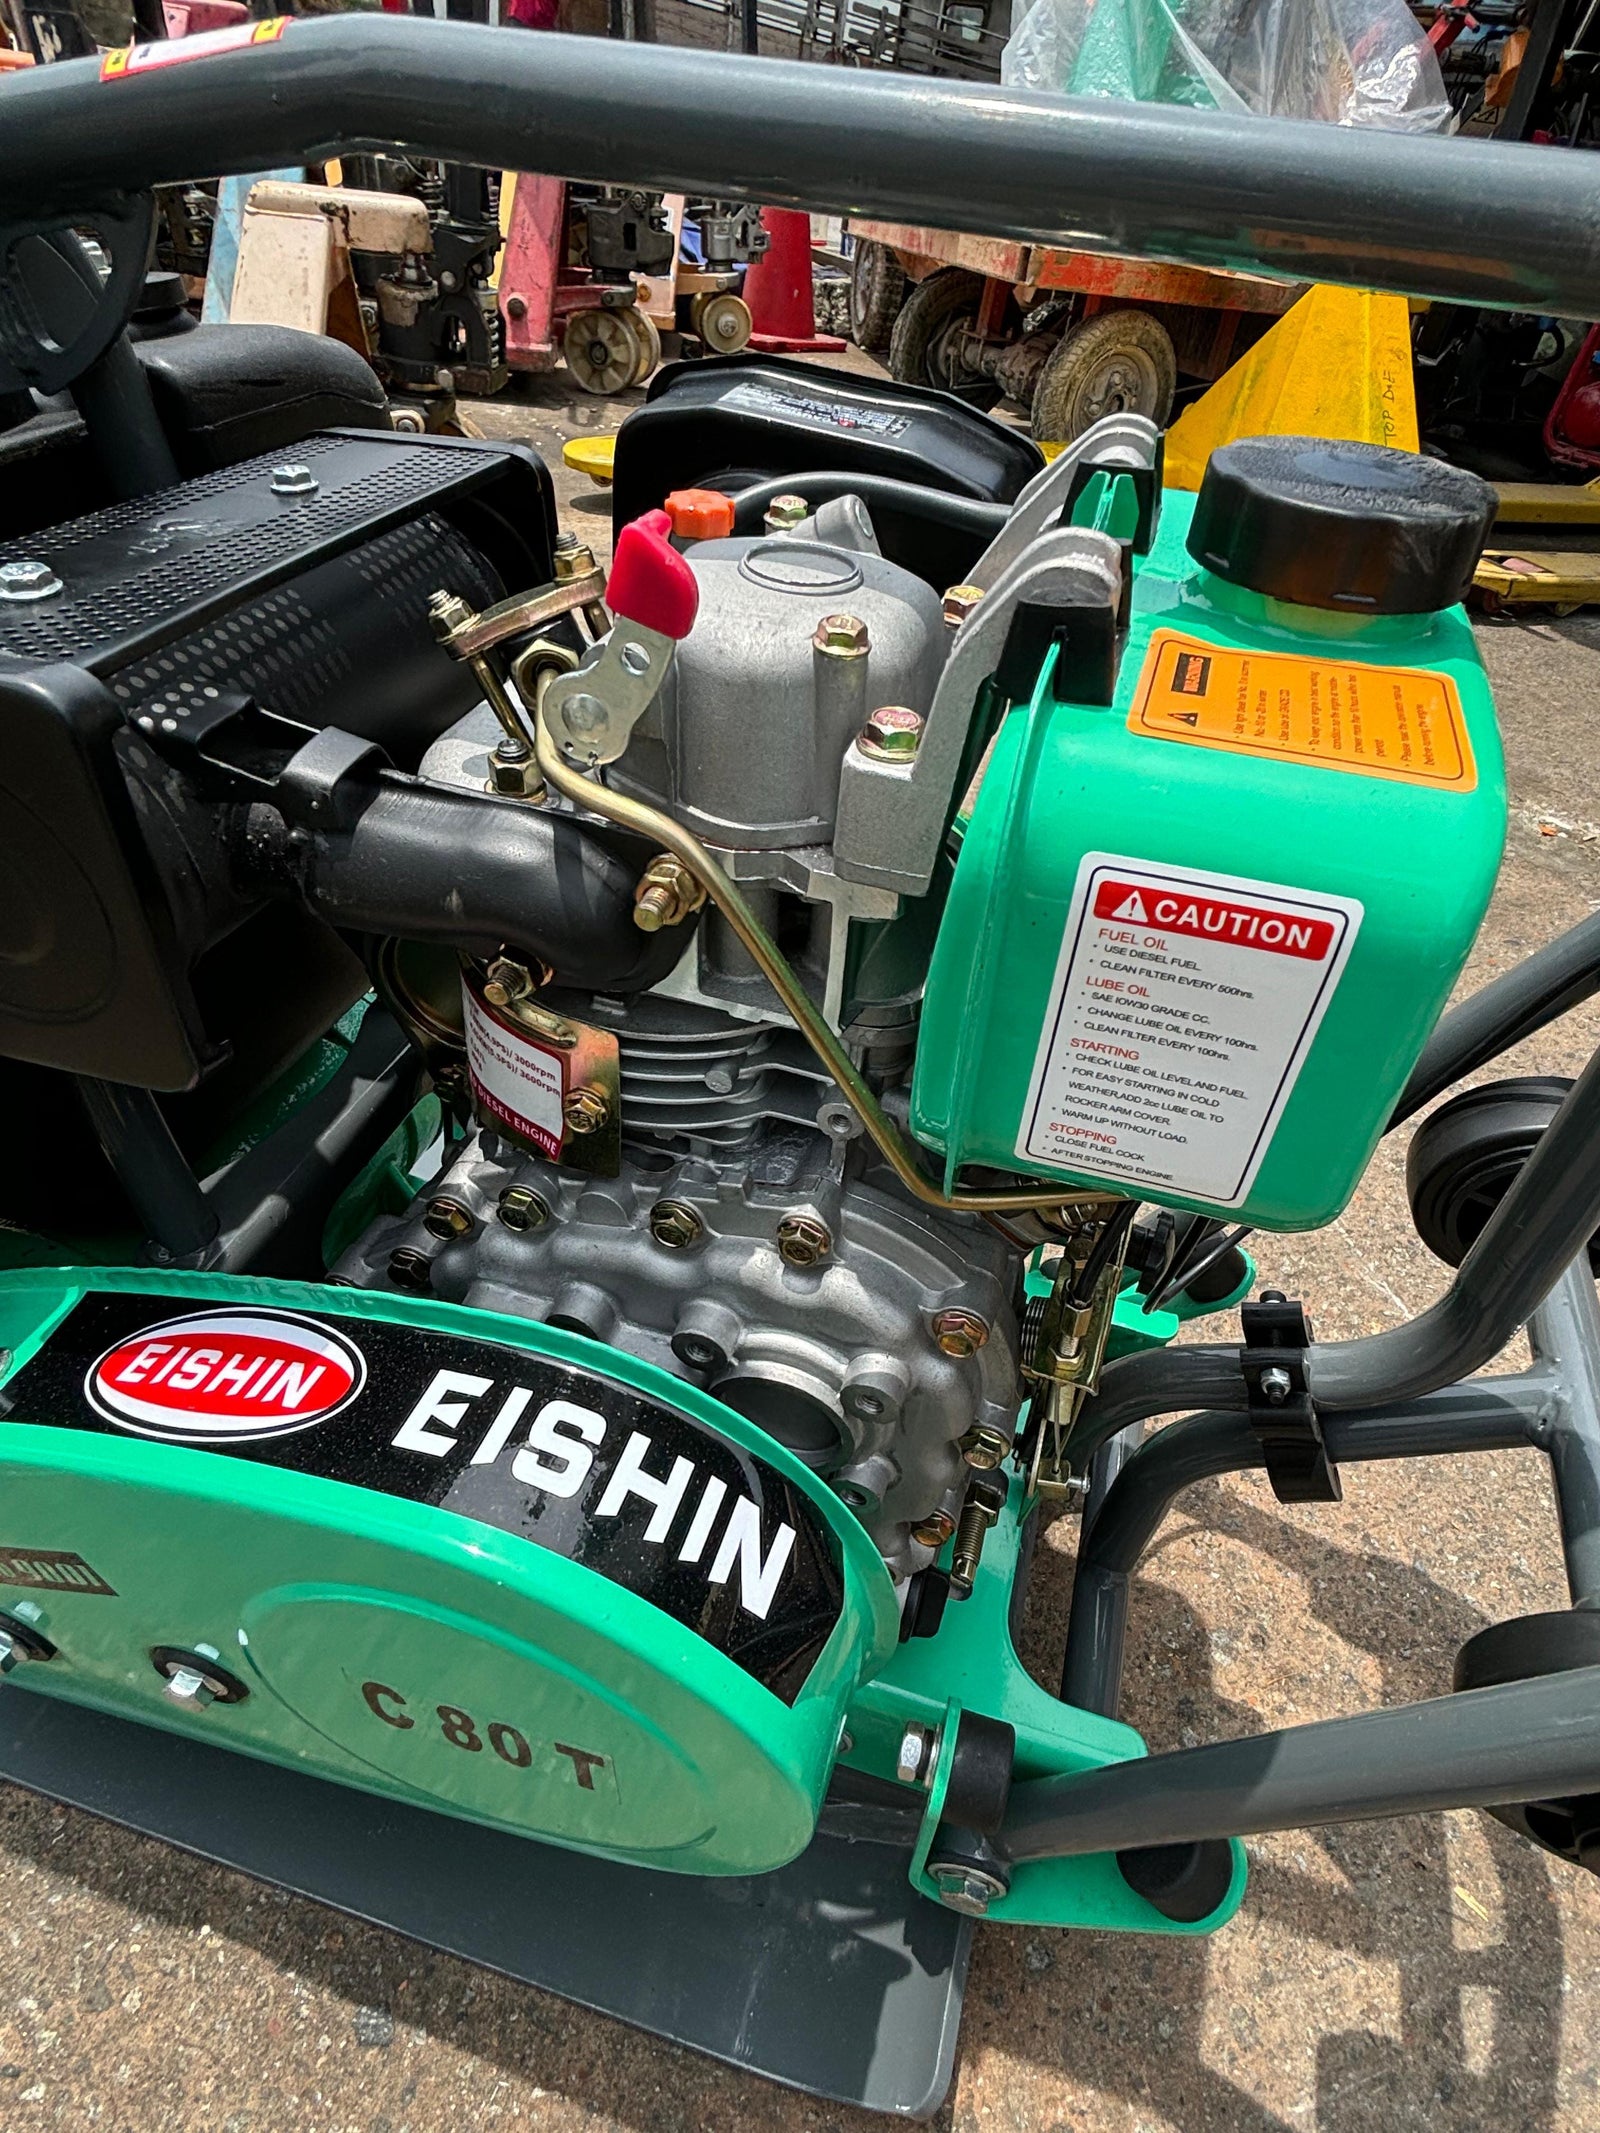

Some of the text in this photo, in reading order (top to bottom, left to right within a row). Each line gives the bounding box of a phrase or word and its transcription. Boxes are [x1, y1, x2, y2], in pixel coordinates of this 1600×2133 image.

[1154, 899, 1313, 950] CAUTION
[1099, 928, 1168, 951] FUEL OIL
[1105, 944, 1128, 955] USE
[1130, 949, 1168, 965] DIESEL
[1086, 976, 1150, 997] LUBE OIL
[1100, 960, 1137, 974] CLEAN
[1139, 969, 1176, 983] FILTER
[1178, 977, 1218, 990] EVERY
[1091, 992, 1113, 1002] SAE
[1151, 1005, 1190, 1019] GRADE
[1084, 1021, 1119, 1035] CLEAN
[1120, 1030, 1156, 1044] FILTER
[1158, 1038, 1195, 1052] EVERY
[1088, 1007, 1133, 1022] CHANGE
[1135, 1017, 1163, 1029] LUBE
[1165, 1024, 1182, 1034] OIL
[1184, 1028, 1222, 1043] EVERY
[1070, 1038, 1140, 1060] STARTING
[1075, 1053, 1111, 1067] CHECK
[1114, 1061, 1140, 1074] LUBE
[1143, 1068, 1158, 1078] OIL
[1161, 1072, 1196, 1087] LEVEL
[1194, 1080, 1218, 1092] AND
[1072, 1067, 1220, 1108] FOR EASY STARTING IN COLD
[1065, 1095, 1108, 1111] ROCKER
[1108, 1104, 1132, 1115] ARM
[1162, 1103, 1188, 1115] LUBE
[1190, 1109, 1207, 1120] OIL
[1210, 1113, 1224, 1123] TO
[478, 1084, 557, 1155] DIESEL ENGINE
[1062, 1109, 1093, 1121] WARM
[1094, 1116, 1109, 1125] UP
[1111, 1120, 1157, 1136] WITHOUT
[1049, 1122, 1117, 1145] STOPPING
[1051, 1148, 1085, 1160] AFTER
[1084, 1155, 1133, 1171] STOPPING
[1055, 1135, 1144, 1161] CLOSE FUEL COCK
[115, 1343, 326, 1409] EISHIN
[391, 1369, 796, 1621] EISHIN
[362, 1681, 604, 1790] C 80 T
